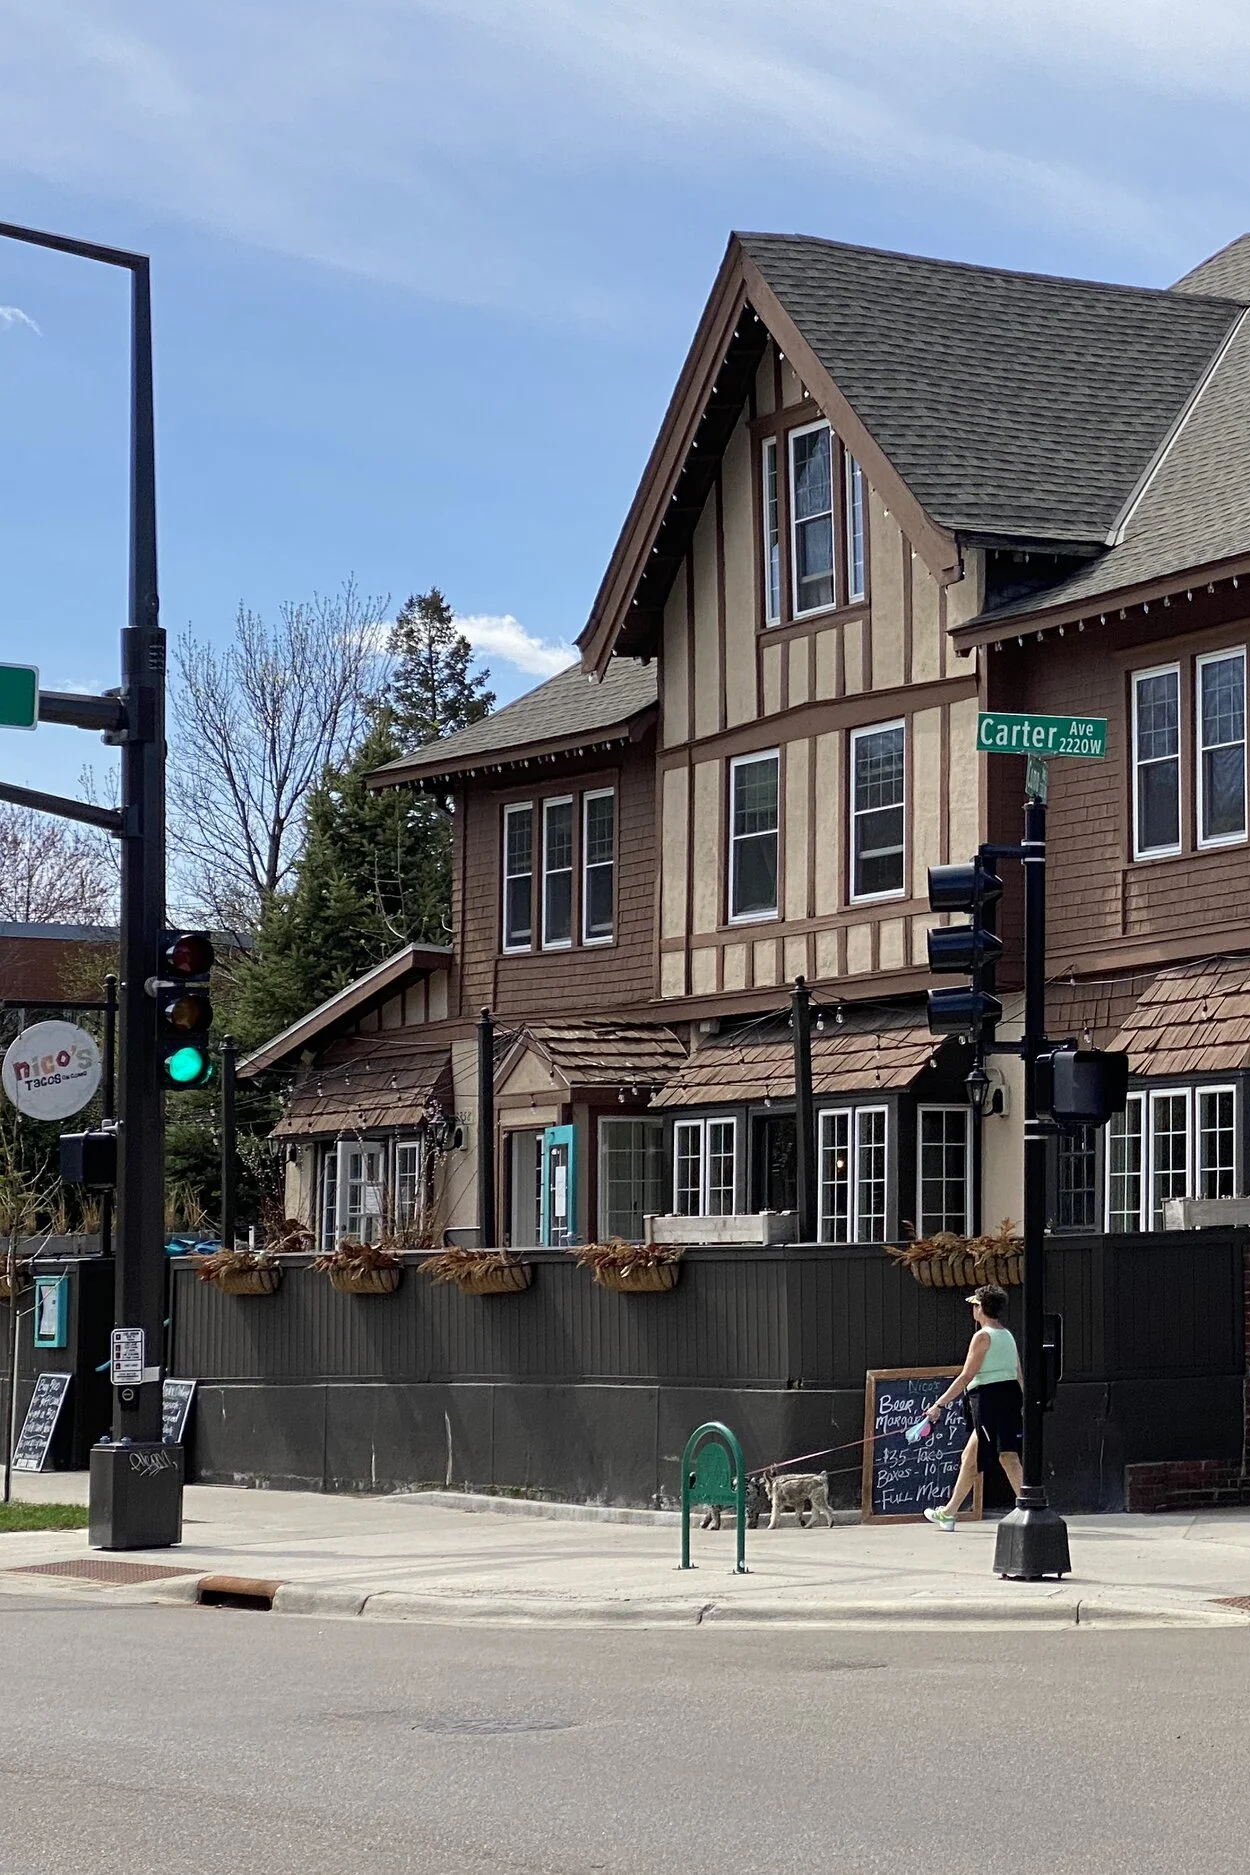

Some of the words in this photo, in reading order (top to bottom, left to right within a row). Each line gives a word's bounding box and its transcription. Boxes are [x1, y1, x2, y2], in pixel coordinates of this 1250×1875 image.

[980, 718, 1058, 748] Carter
[1069, 721, 1094, 737] Ave
[1059, 738, 1102, 754] 2220W
[913, 1446, 944, 1463] Taco
[876, 1468, 912, 1488] Boxes
[916, 1481, 952, 1501] Men
